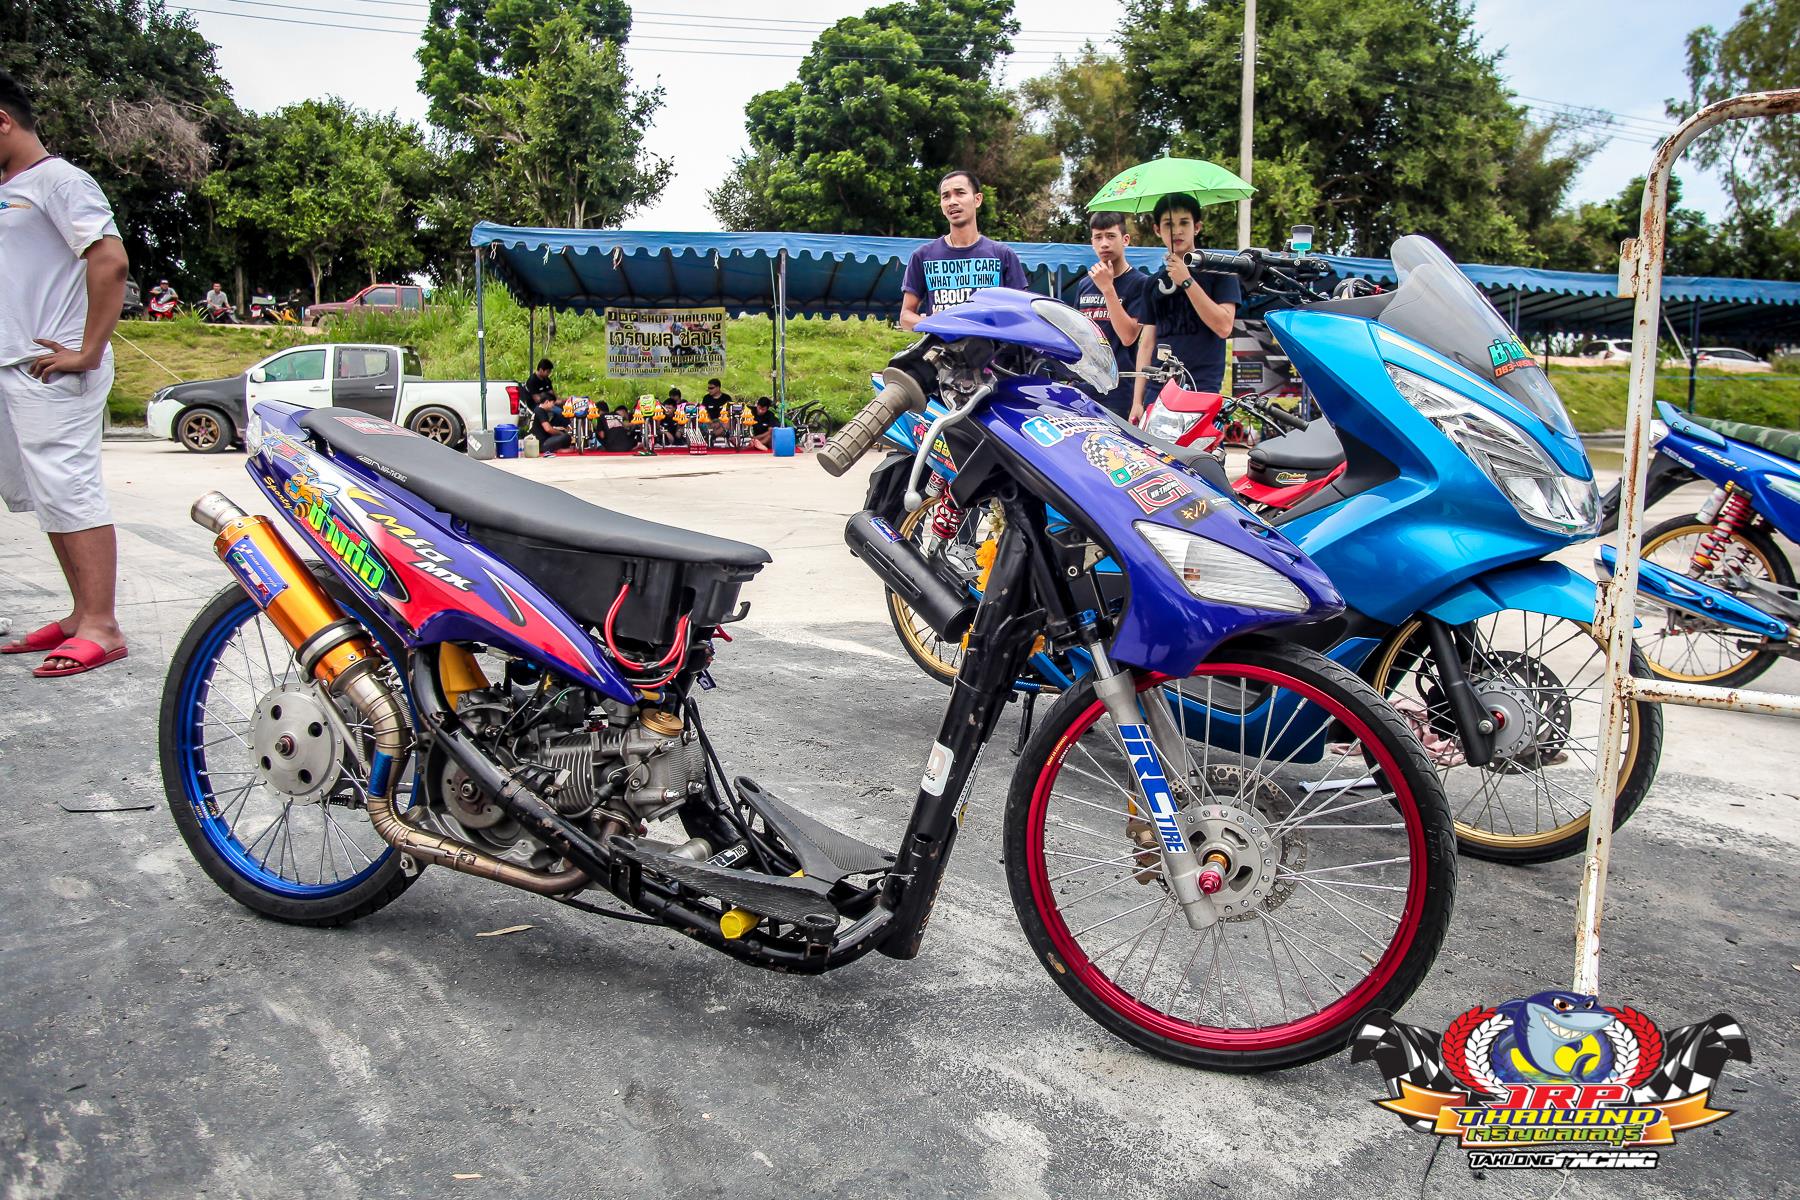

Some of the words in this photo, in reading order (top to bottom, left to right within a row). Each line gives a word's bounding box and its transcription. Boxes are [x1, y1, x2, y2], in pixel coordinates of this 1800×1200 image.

[924, 261, 939, 274] WE
[942, 260, 971, 274] DON'T
[974, 259, 1000, 272] CARE
[929, 276, 951, 288] WHAT
[955, 275, 970, 285] YOU
[973, 274, 994, 285] THINK
[934, 288, 972, 304] ABOUT
[641, 315, 669, 323] SHOP
[673, 313, 722, 322] THAILAND
[263, 475, 293, 510] Sporty
[1155, 814, 1188, 853] TIRE
